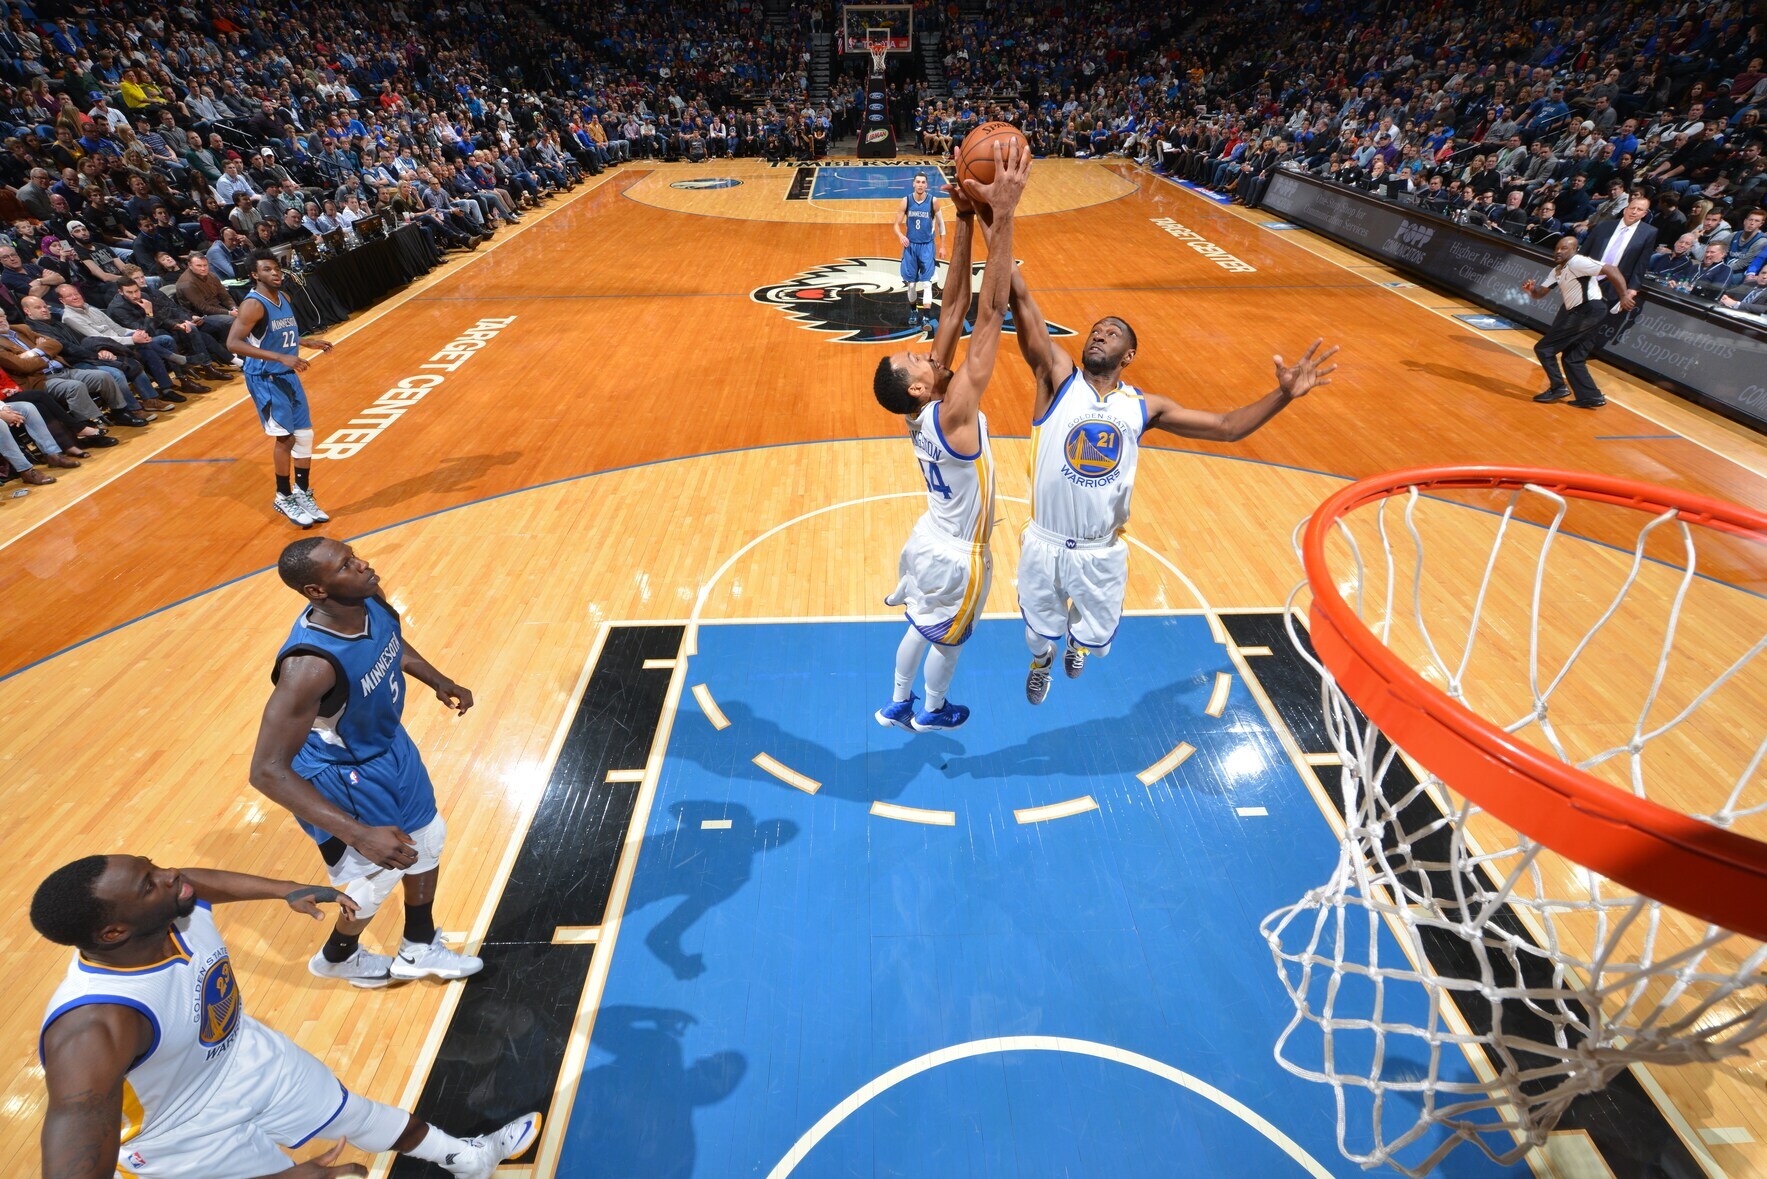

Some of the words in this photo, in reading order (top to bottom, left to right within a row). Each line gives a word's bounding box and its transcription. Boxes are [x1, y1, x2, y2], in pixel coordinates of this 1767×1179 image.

[862, 40, 897, 48] TOOTA
[768, 160, 956, 168] TIMBERWOLV
[915, 219, 921, 230] 8
[1393, 219, 1434, 249] POPP
[1149, 217, 1206, 242] TARGET
[1186, 241, 1257, 273] CENTER
[1449, 241, 1481, 263] Higher
[1480, 252, 1529, 282] Reliability
[1459, 264, 1487, 285] Client
[271, 316, 298, 332] MINNESOT
[282, 330, 297, 348] 22
[1626, 306, 1737, 359] Configurations
[419, 315, 518, 372] TARGET
[1631, 333, 1696, 371] Support
[311, 374, 445, 460] CENTER
[1067, 412, 1105, 429] GOLDEN
[1107, 415, 1129, 436] STATE
[1096, 431, 1116, 449] 21
[1060, 463, 1122, 489] WARRIORS
[360, 631, 401, 698] MINNESOTA
[388, 670, 400, 705] 5
[193, 966, 206, 1024] GOLDEN
[206, 946, 229, 966] STATE
